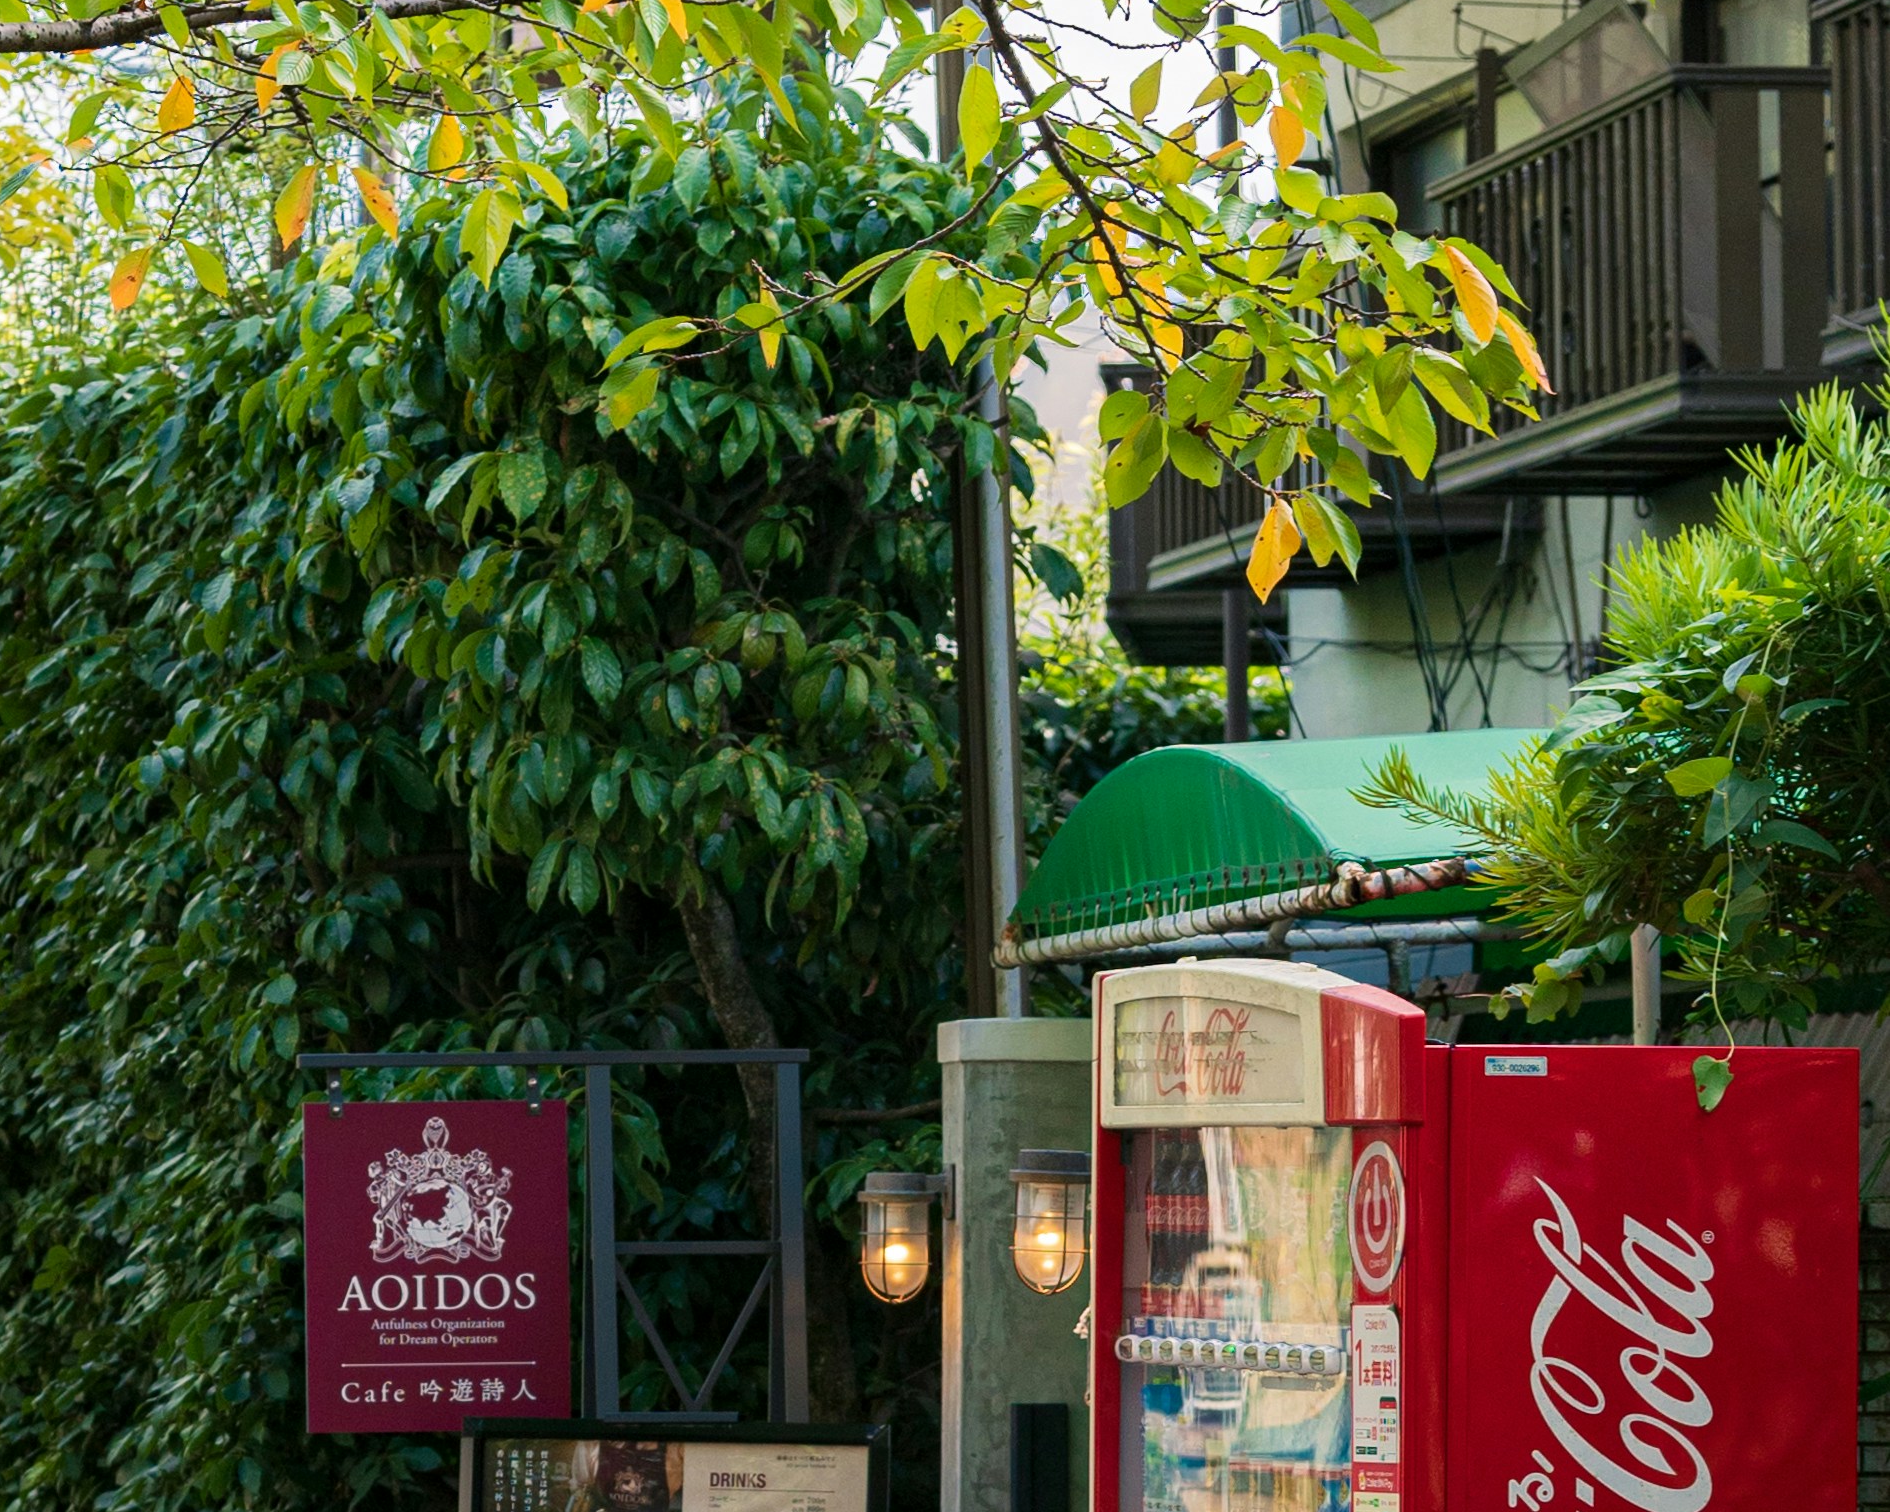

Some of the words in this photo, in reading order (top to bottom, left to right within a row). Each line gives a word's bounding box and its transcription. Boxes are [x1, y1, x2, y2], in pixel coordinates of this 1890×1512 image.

[337, 1272, 536, 1312] AOIDOS
[371, 1318, 428, 1330] Artfulness
[430, 1317, 505, 1332] Organization
[379, 1333, 396, 1345] for
[399, 1333, 438, 1345] Dream
[441, 1332, 498, 1347] Operators
[341, 1380, 406, 1403] Cafe
[419, 1377, 537, 1403] 吟遊詩人
[710, 1472, 767, 1488] DRINKS
